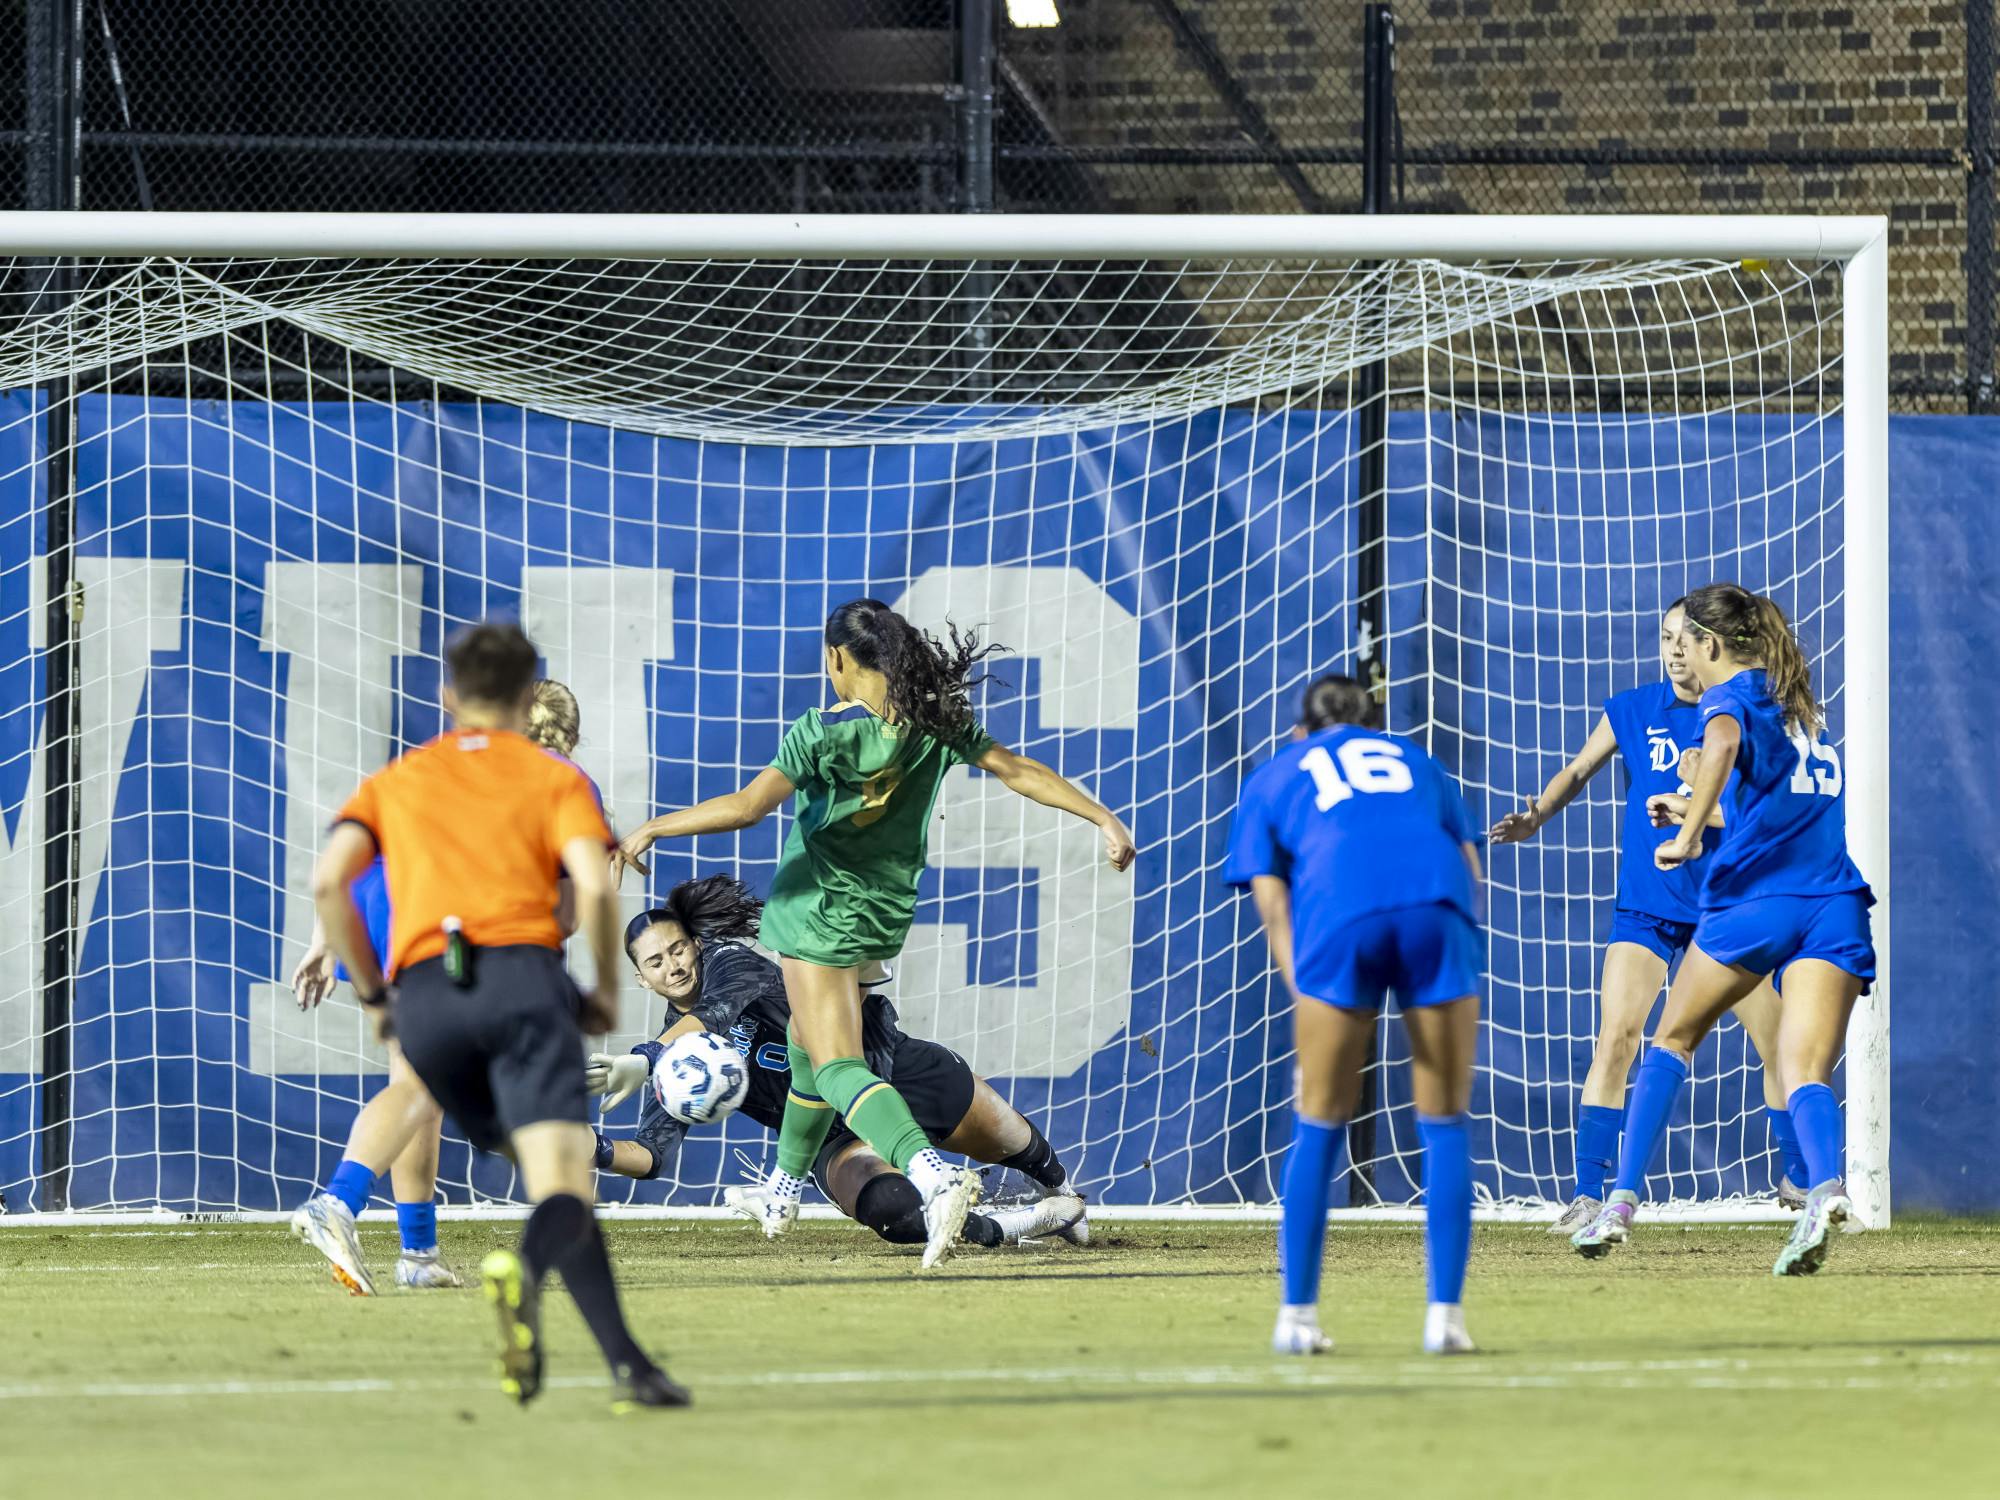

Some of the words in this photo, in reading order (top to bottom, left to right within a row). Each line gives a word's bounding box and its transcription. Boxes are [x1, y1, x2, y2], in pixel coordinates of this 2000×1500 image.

[1298, 738, 1414, 812] 16
[1784, 713, 1842, 797] 15
[756, 1042, 791, 1072] 0
